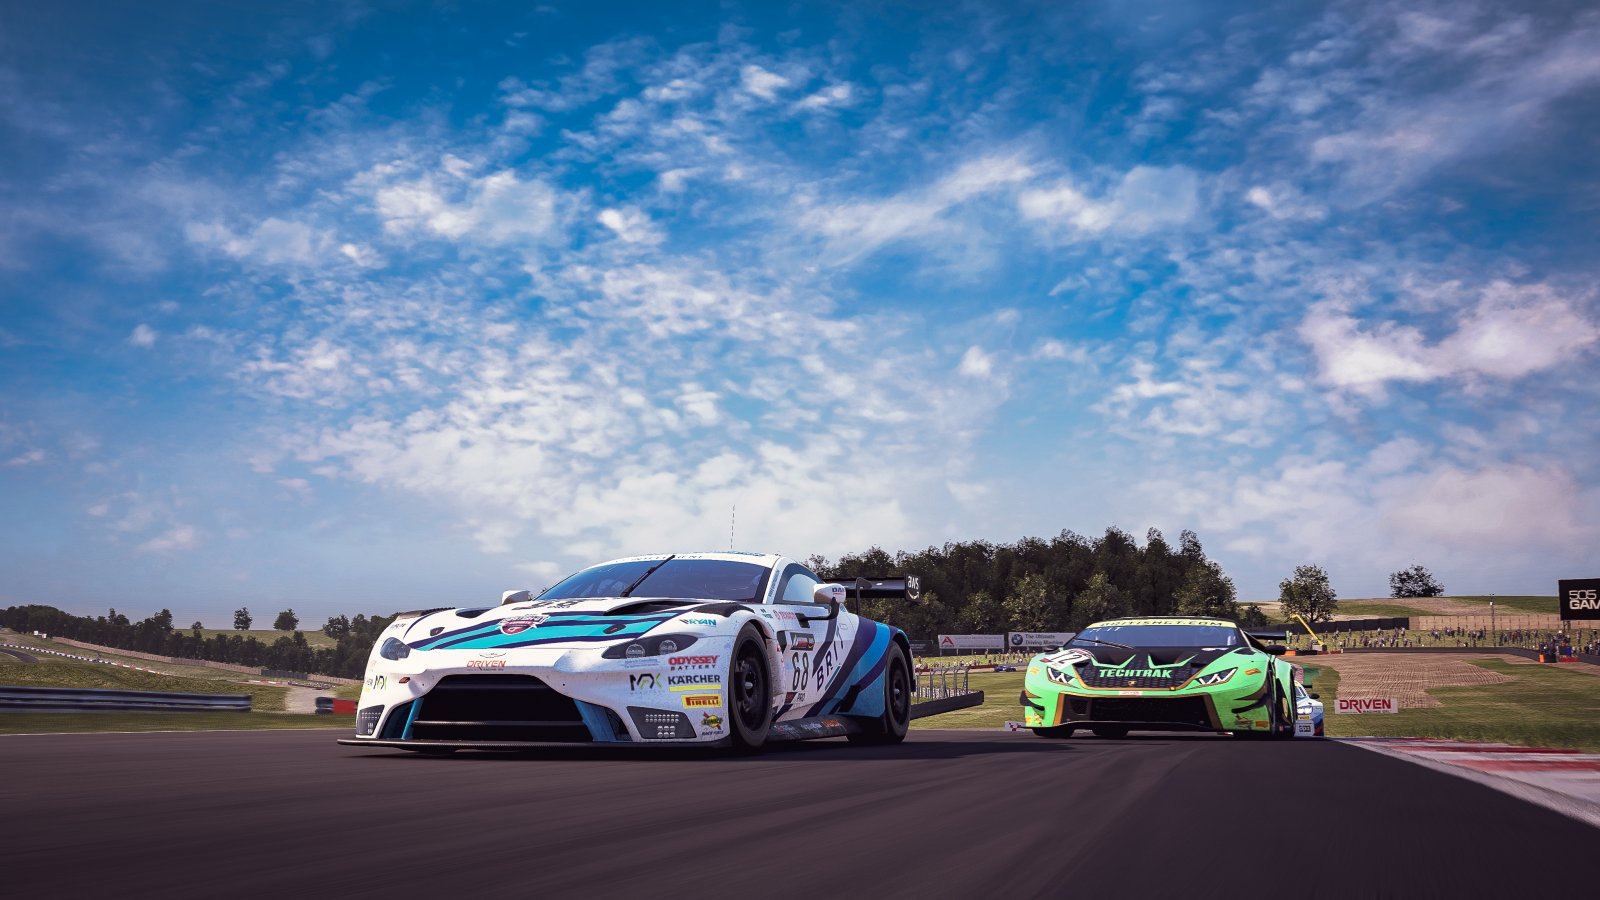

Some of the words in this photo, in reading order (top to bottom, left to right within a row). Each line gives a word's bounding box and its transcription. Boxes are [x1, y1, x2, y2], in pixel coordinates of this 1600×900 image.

[908, 575, 919, 589] aws
[1569, 590, 1597, 600] 505
[466, 660, 507, 670] DRIVEN
[668, 655, 718, 665] ODYSSEY
[792, 652, 809, 691] 68
[1100, 669, 1173, 678] TECHTRAK
[668, 674, 720, 685] KÄRCHER
[685, 695, 719, 706] PIRELLI
[1339, 699, 1391, 713] DRIVEN
